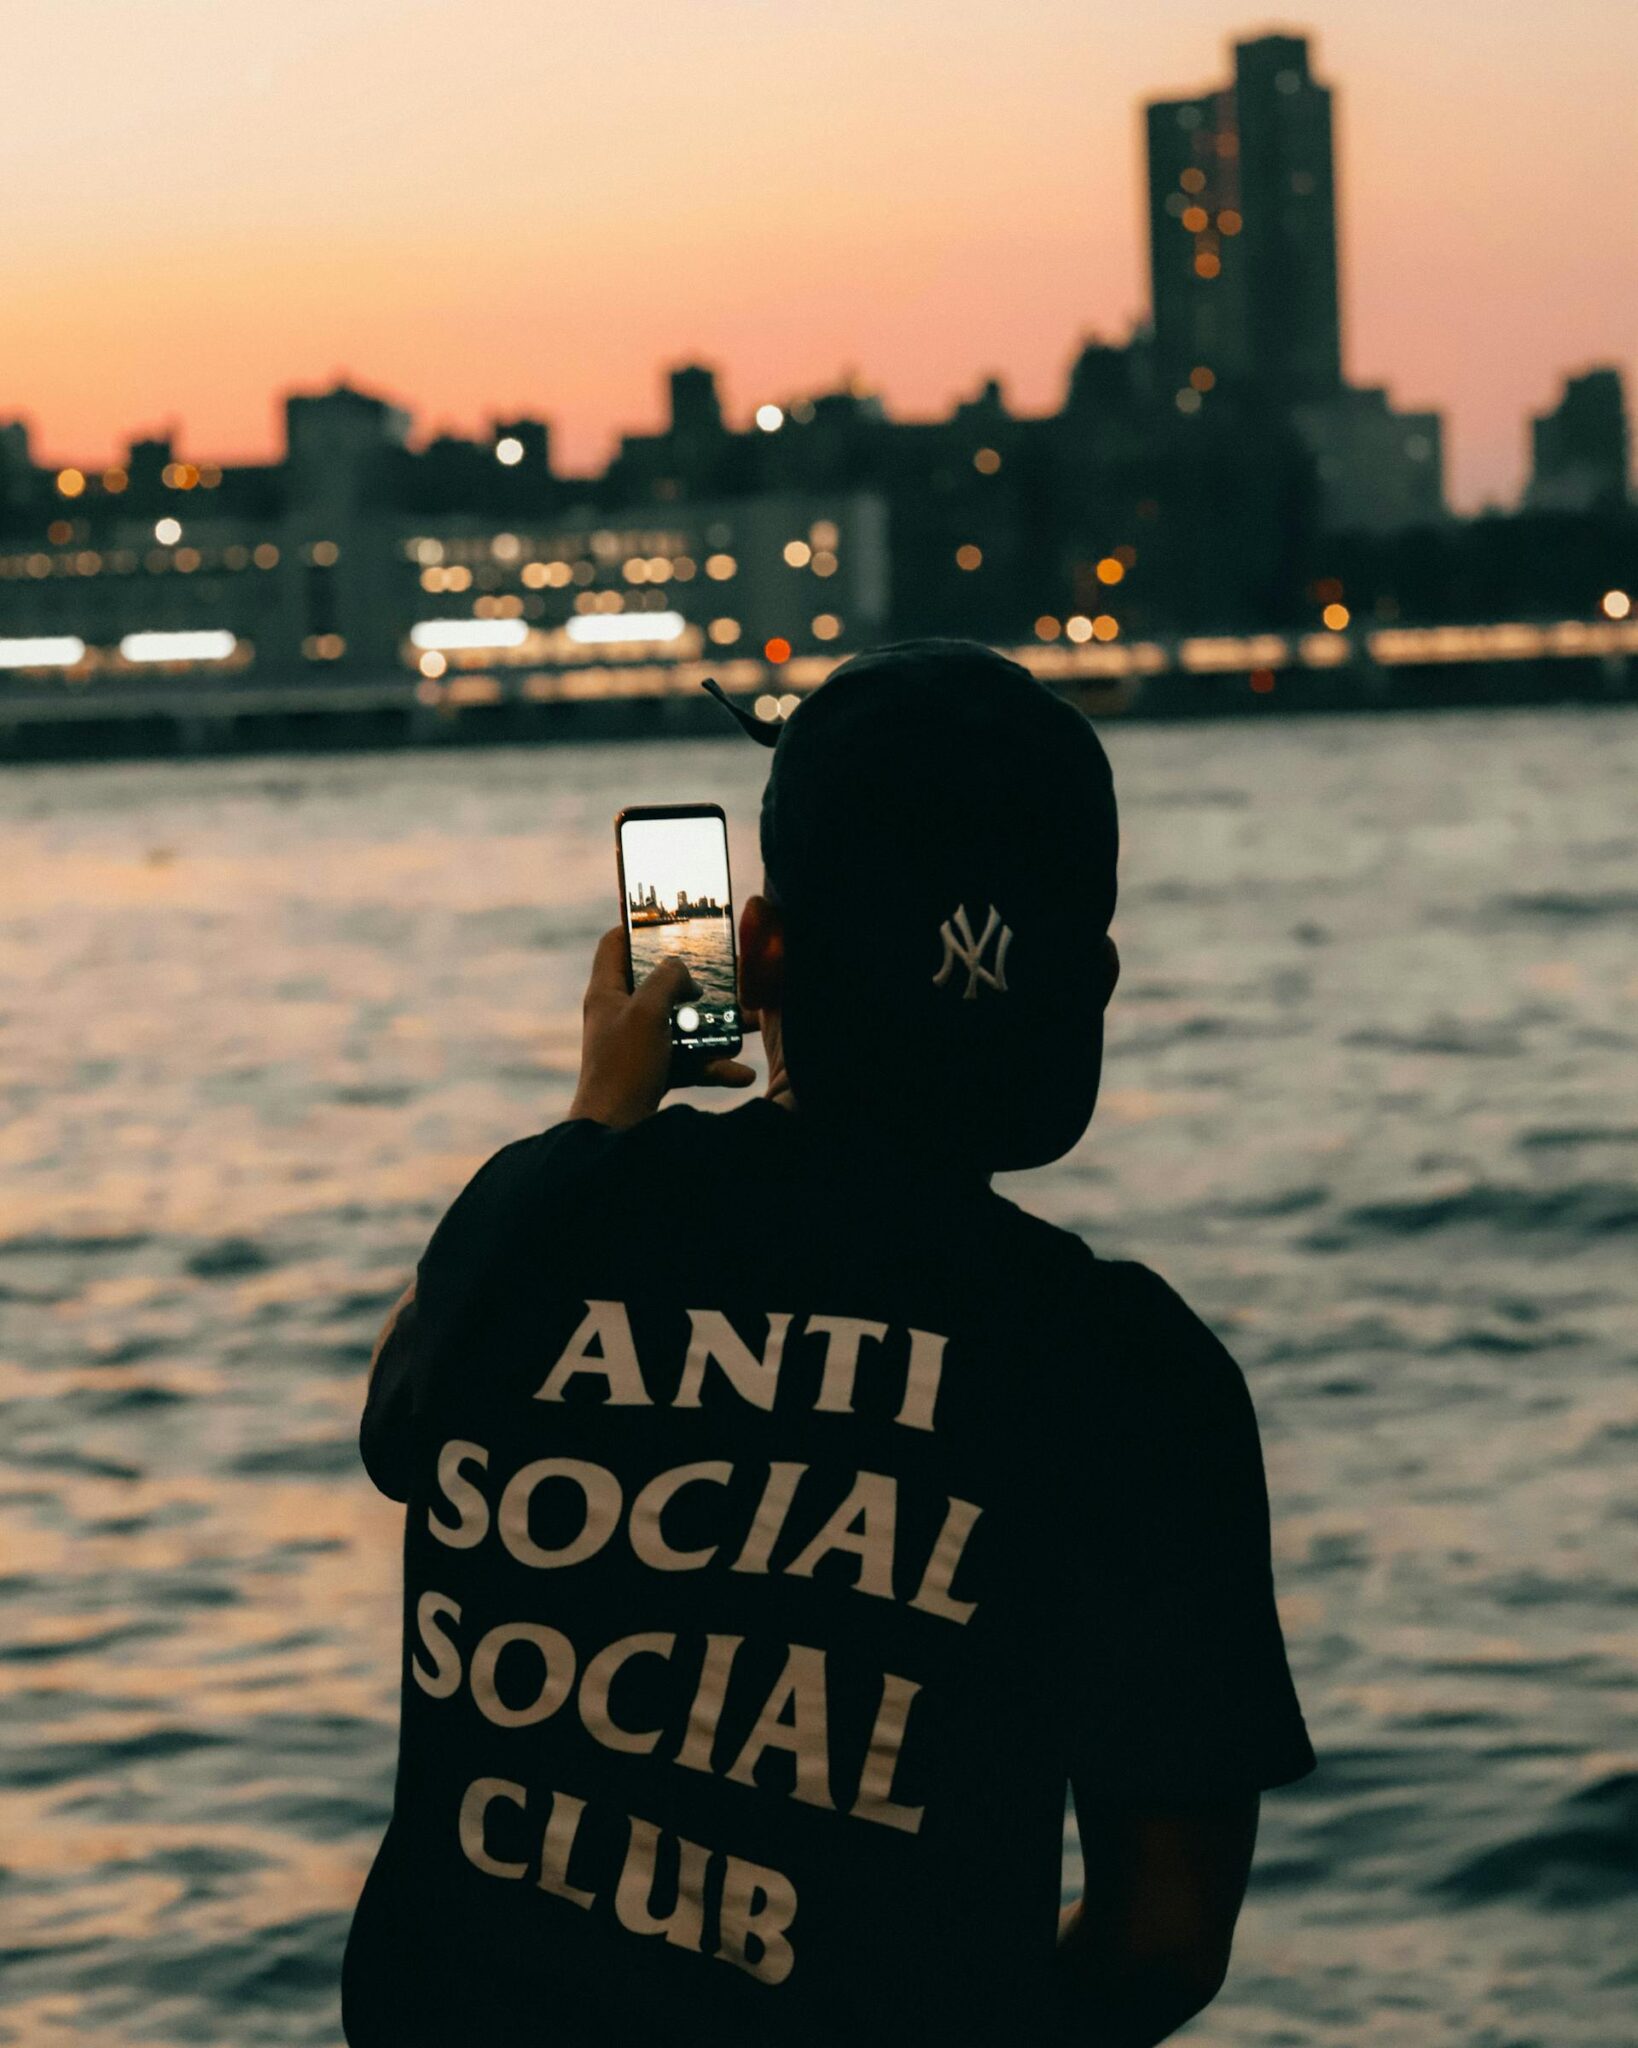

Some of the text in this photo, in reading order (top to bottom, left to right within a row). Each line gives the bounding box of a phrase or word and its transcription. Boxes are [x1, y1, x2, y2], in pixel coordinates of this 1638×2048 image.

[932, 903, 1013, 1000] NY
[534, 1300, 948, 1433] ANTI
[427, 1440, 983, 1626] SOCIAL
[411, 1591, 925, 1835] SOCIAL
[459, 1777, 798, 1985] CLUB
